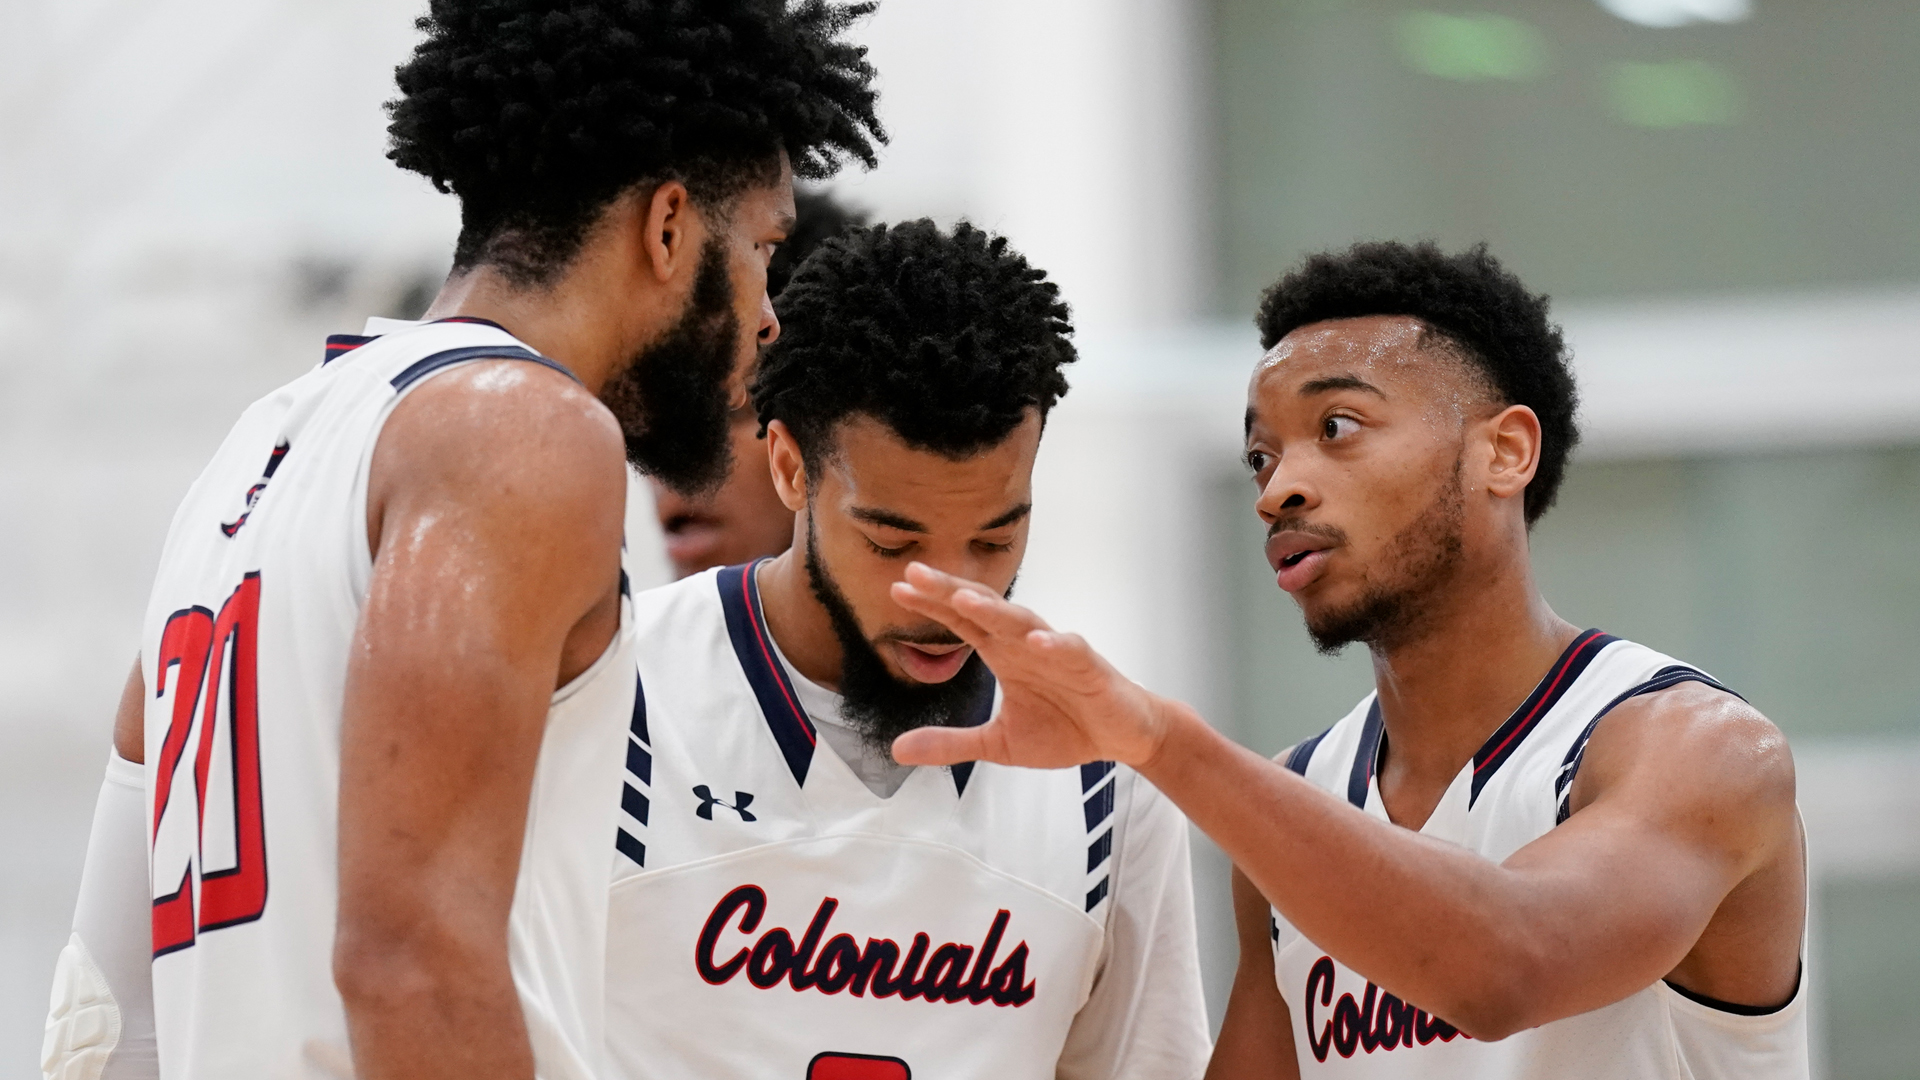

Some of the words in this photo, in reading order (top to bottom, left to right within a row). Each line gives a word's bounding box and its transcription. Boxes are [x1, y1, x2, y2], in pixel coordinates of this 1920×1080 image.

[152, 569, 268, 961] 20
[695, 884, 1036, 1007] Colonials
[1305, 955, 1475, 1063] Colon
